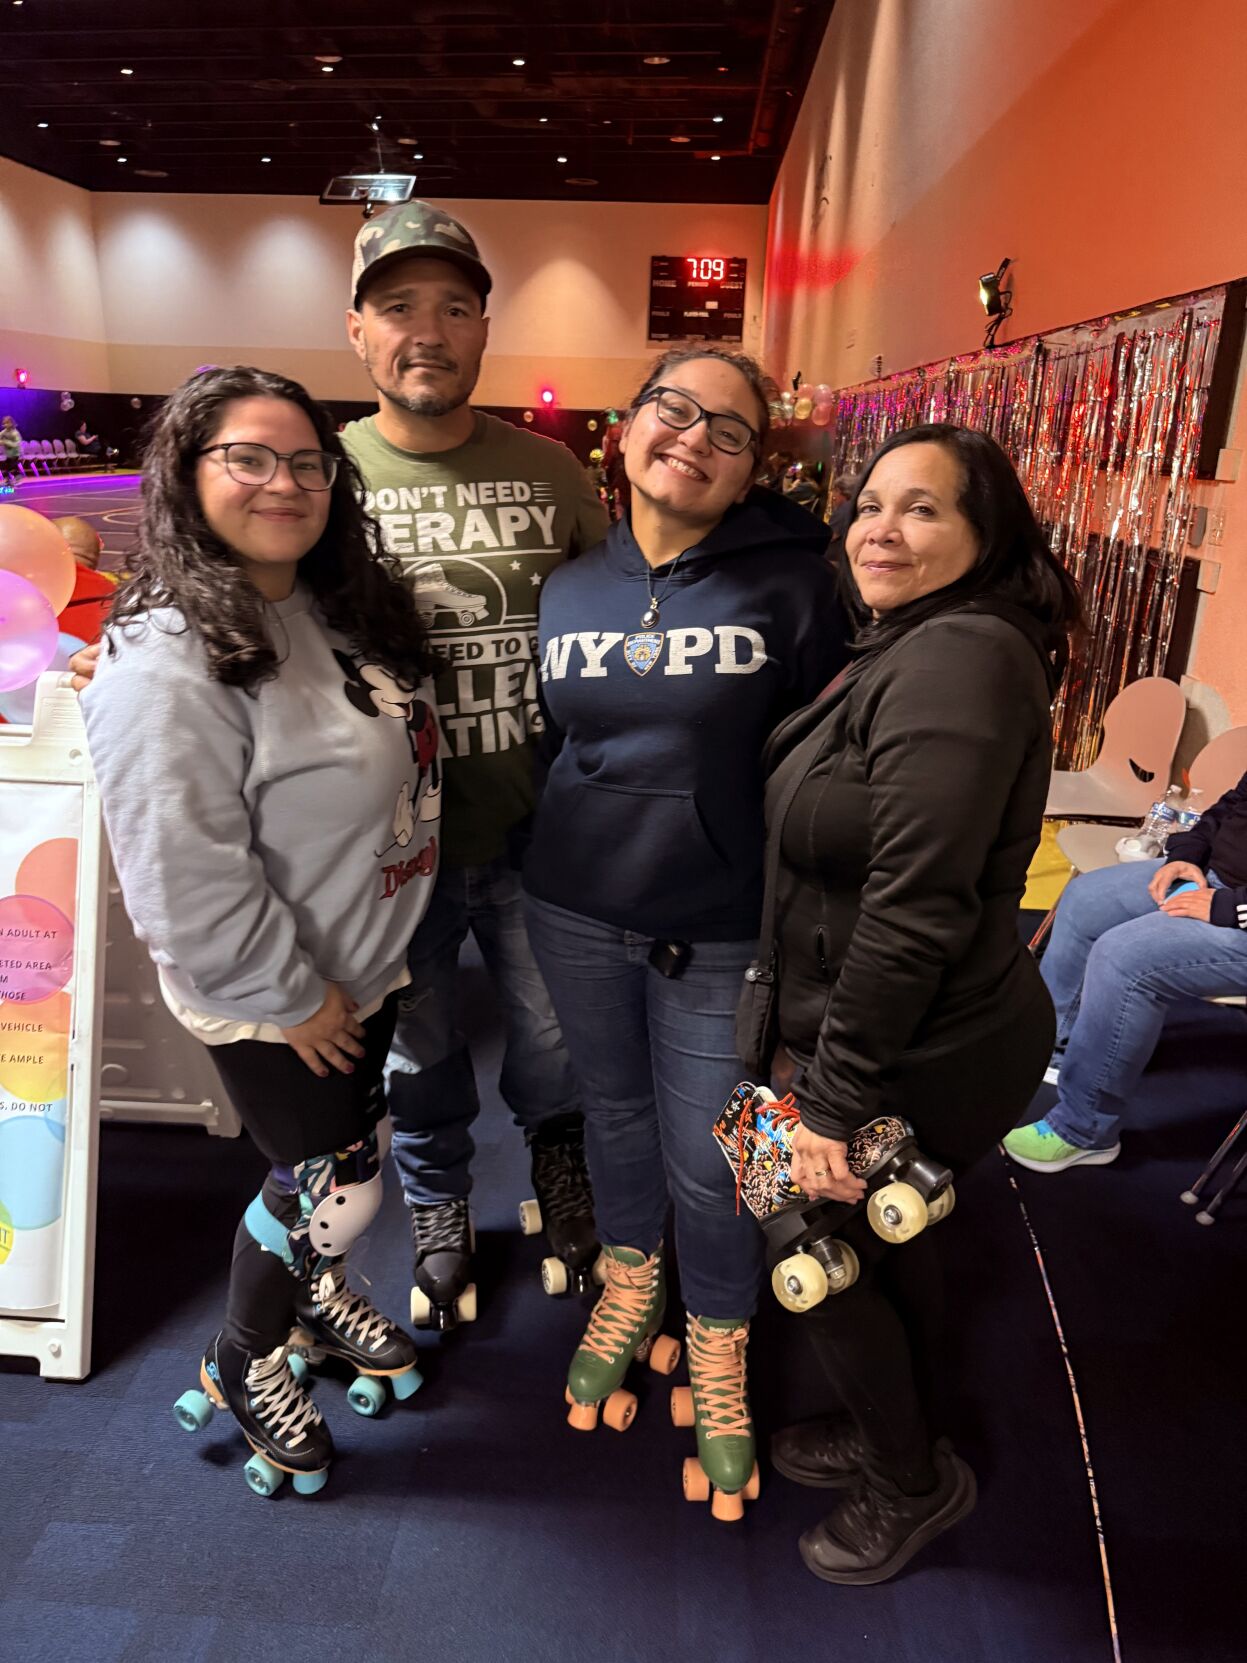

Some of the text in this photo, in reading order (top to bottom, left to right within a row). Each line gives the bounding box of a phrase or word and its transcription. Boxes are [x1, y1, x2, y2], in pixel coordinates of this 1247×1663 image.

[456, 481, 531, 507] NEED
[362, 506, 556, 553] ERAPY
[429, 642, 484, 661] EED
[491, 637, 521, 658] TO
[437, 702, 545, 758] TING
[7, 928, 41, 938] ADULT
[43, 930, 58, 939] AT
[0, 960, 52, 970] ETED AREA
[0, 989, 27, 1001] HOSE
[0, 1022, 44, 1033] VEHICLE
[9, 1054, 44, 1065] AMPLE
[11, 1102, 27, 1112] DO
[29, 1103, 53, 1113] NOT
